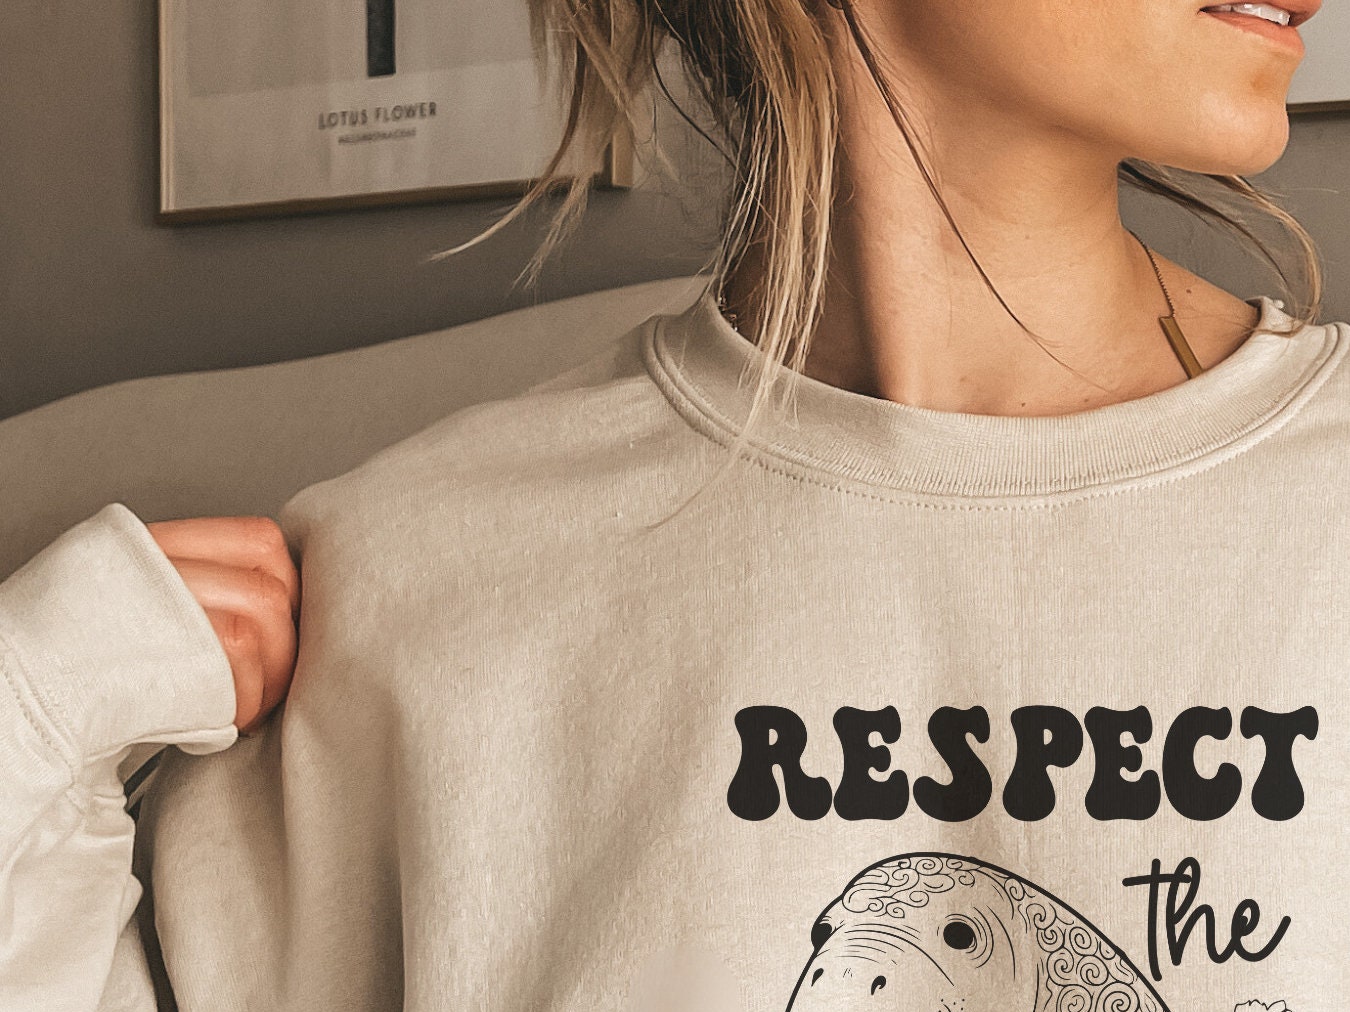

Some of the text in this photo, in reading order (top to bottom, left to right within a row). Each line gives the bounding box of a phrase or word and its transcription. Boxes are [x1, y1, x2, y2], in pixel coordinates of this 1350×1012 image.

[318, 101, 437, 130] LOTUS FLOWER
[727, 705, 1319, 822] RESPECT
[1122, 857, 1291, 982] the
